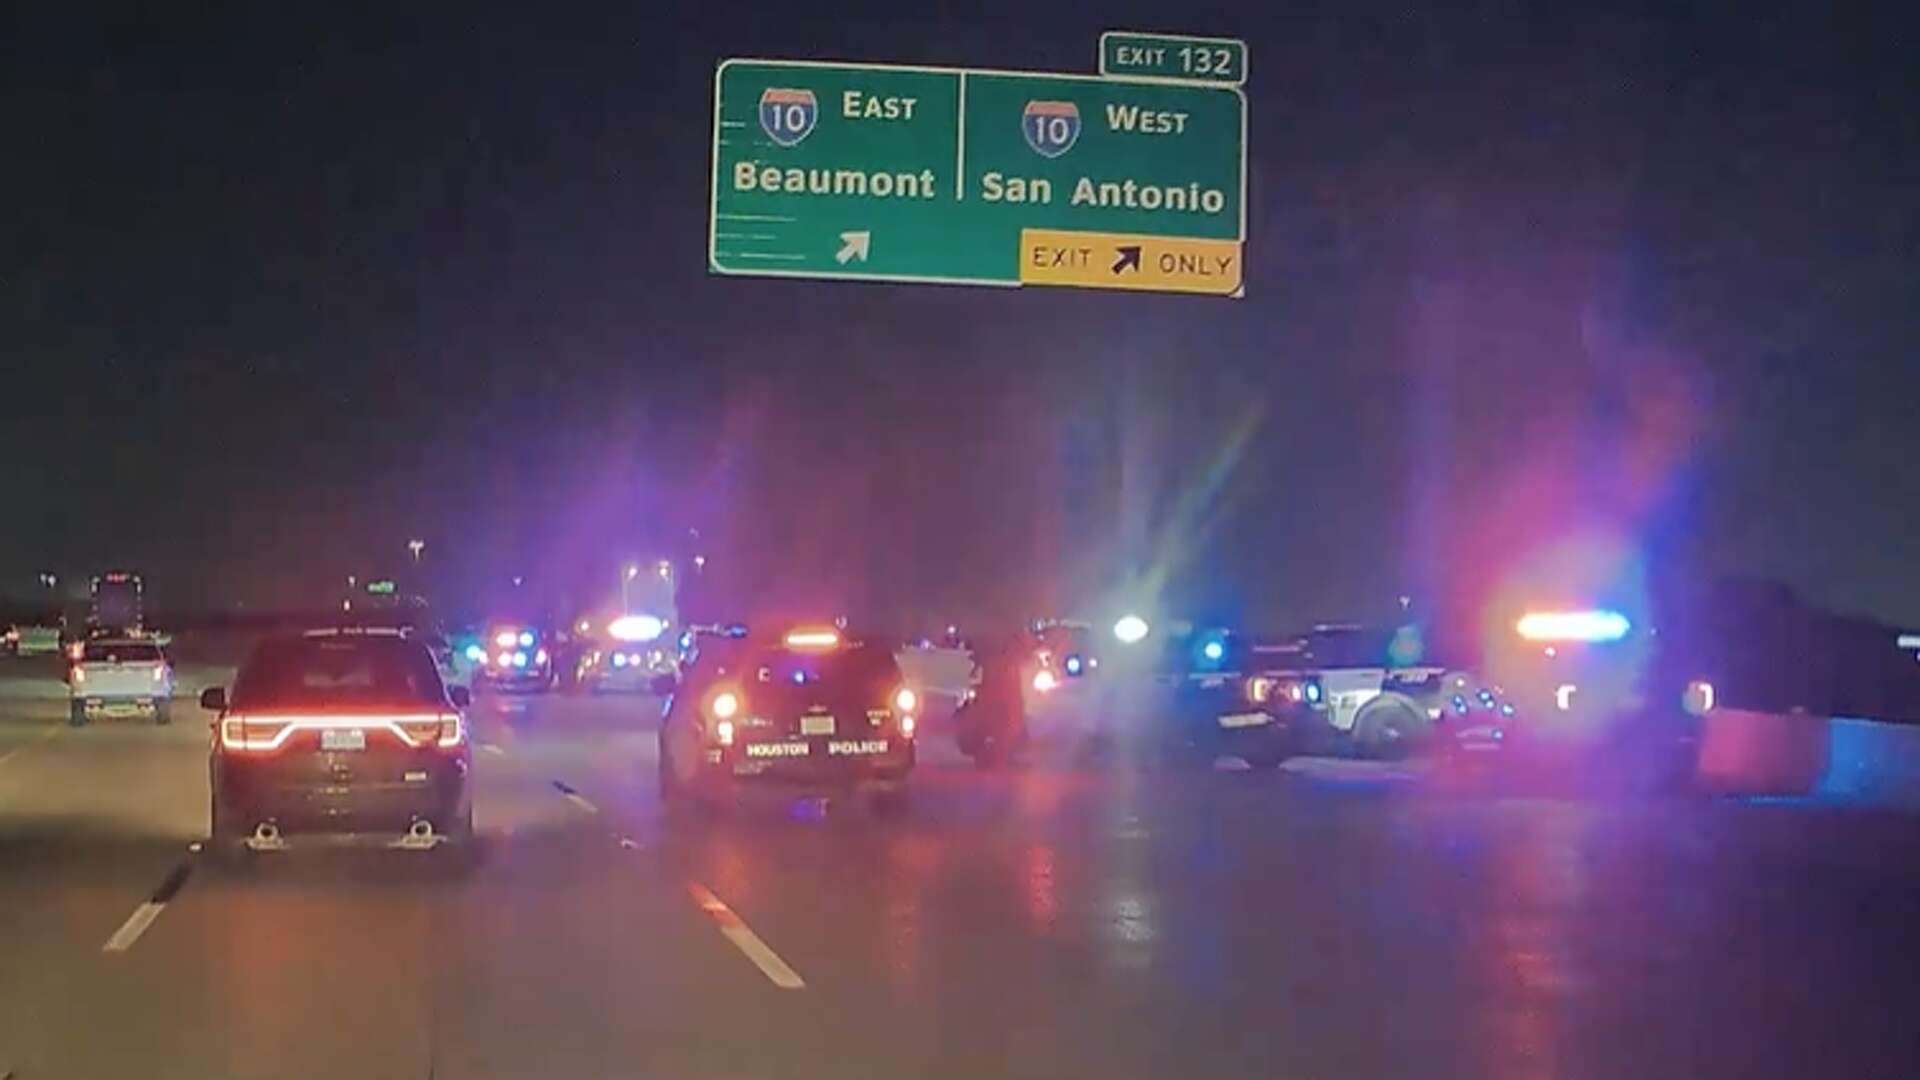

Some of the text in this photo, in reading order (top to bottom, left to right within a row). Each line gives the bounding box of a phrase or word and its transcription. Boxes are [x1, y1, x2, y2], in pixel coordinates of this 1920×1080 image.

[1116, 45, 1232, 74] EXIT 132
[769, 102, 805, 132] 10
[842, 91, 917, 120] EAST
[1106, 104, 1189, 134] WEST
[1032, 116, 1069, 145] 10
[734, 161, 936, 199] Beaumont
[982, 172, 1225, 213] San Antonio
[1032, 246, 1233, 277] EXIT ONLY
[746, 740, 888, 756] HOUSTON POLICE
